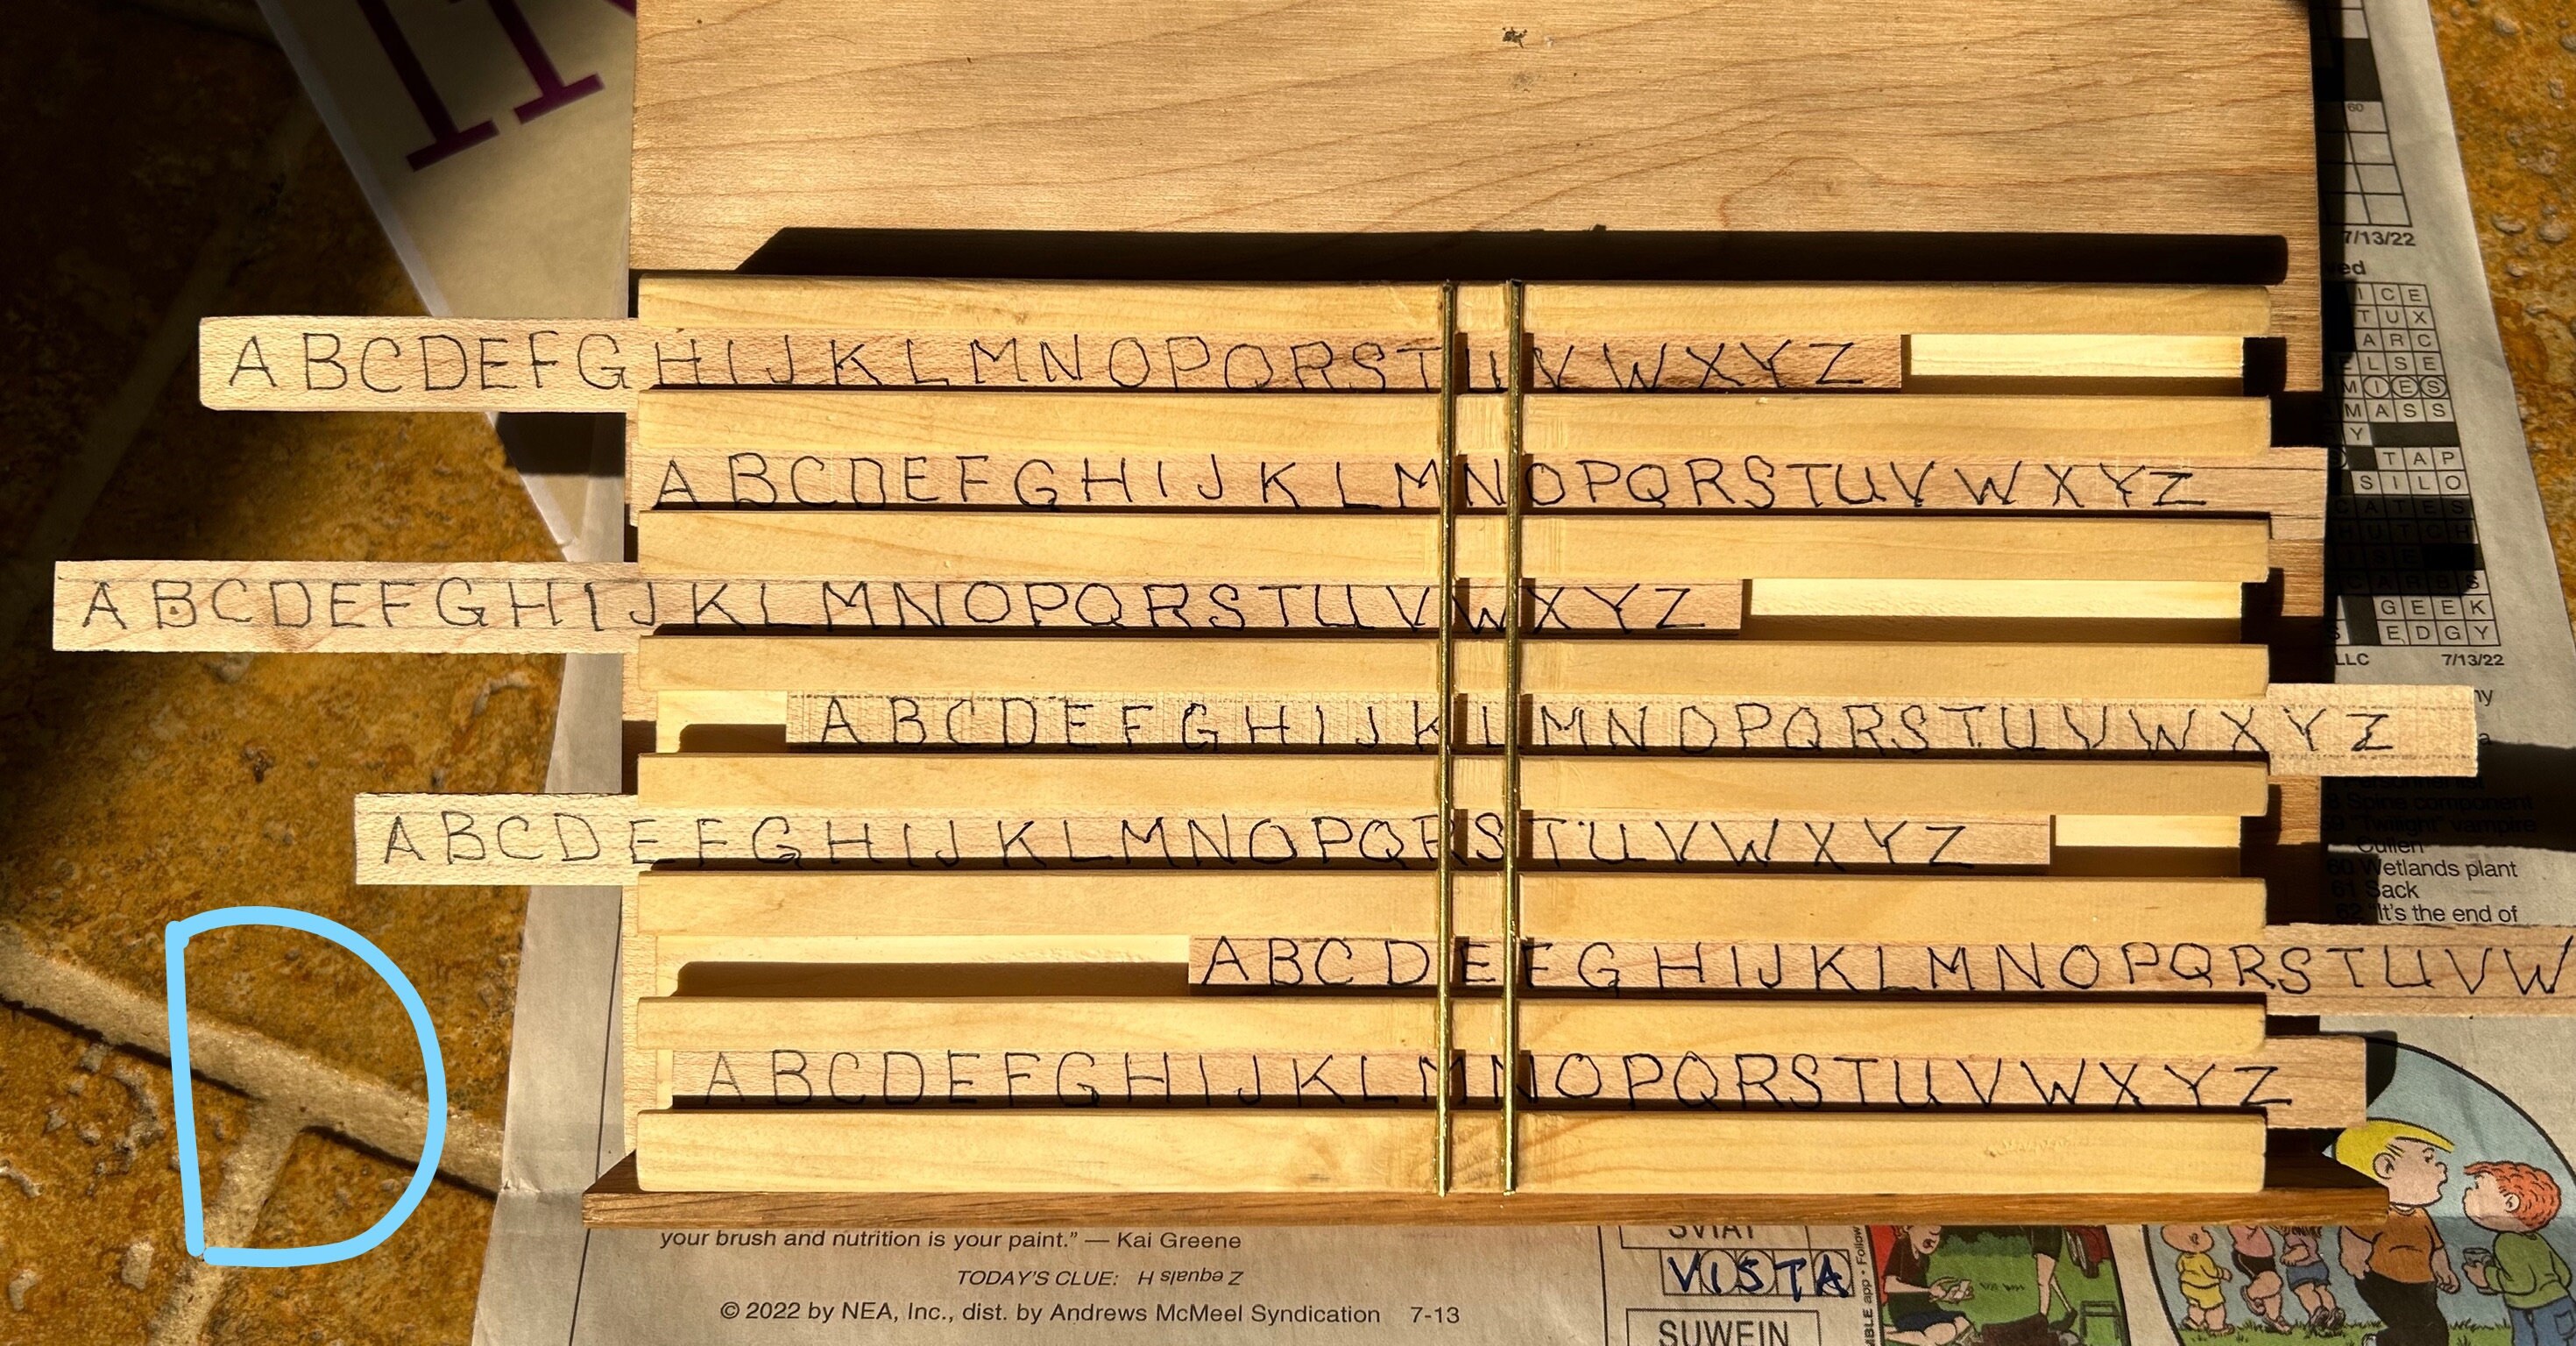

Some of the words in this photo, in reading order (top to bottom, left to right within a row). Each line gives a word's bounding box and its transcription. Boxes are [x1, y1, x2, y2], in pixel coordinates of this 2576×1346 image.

[2347, 103, 2364, 112] 60
[2342, 231, 2415, 245] 7/13/22
[2358, 287, 2420, 301] ICE
[2358, 310, 2425, 324] TUX
[2363, 334, 2431, 347] ARC
[2383, 451, 2454, 465] TAP
[2360, 476, 2461, 490] SILO
[2381, 600, 2486, 614] GEEK
[2388, 626, 2488, 640] EDGY
[2334, 654, 2370, 665] LLC
[2442, 655, 2504, 666] 7/13/22
[2357, 836, 2424, 854] Cullen
[2327, 859, 2355, 875] 60
[2358, 858, 2460, 877] Wetlands
[2466, 860, 2518, 880] plant
[2332, 880, 2356, 898] 61
[2366, 880, 2420, 899] Sack
[2336, 903, 2364, 921] 62
[2414, 903, 2445, 922] the
[2452, 905, 2492, 923] end
[2498, 904, 2518, 923] of
[660, 1230, 710, 1249] your
[716, 1229, 776, 1246] brush
[783, 1229, 825, 1247] and
[832, 1229, 921, 1247] nutrition
[929, 1229, 946, 1247] is
[953, 1233, 1002, 1250] your
[1118, 1231, 1152, 1249] Kai
[1160, 1232, 1242, 1249] Greene
[1054, 1270, 1119, 1286] CLUE:
[1138, 1271, 1154, 1286] H
[1667, 1250, 1849, 1301] VISTA
[1862, 1279, 1873, 1304] app
[746, 1301, 801, 1319] 2022
[808, 1301, 834, 1324] by
[842, 1301, 898, 1322] NEA,
[908, 1302, 953, 1324] Inc.,
[963, 1302, 1008, 1321] dist.
[1016, 1303, 1043, 1324] by
[1050, 1303, 1148, 1321] Andrews
[1156, 1303, 1242, 1322] McMeel
[1251, 1304, 1380, 1326] Syndication
[1411, 1306, 1460, 1324] 7-13
[1659, 1320, 1788, 1346] SUWEIN
